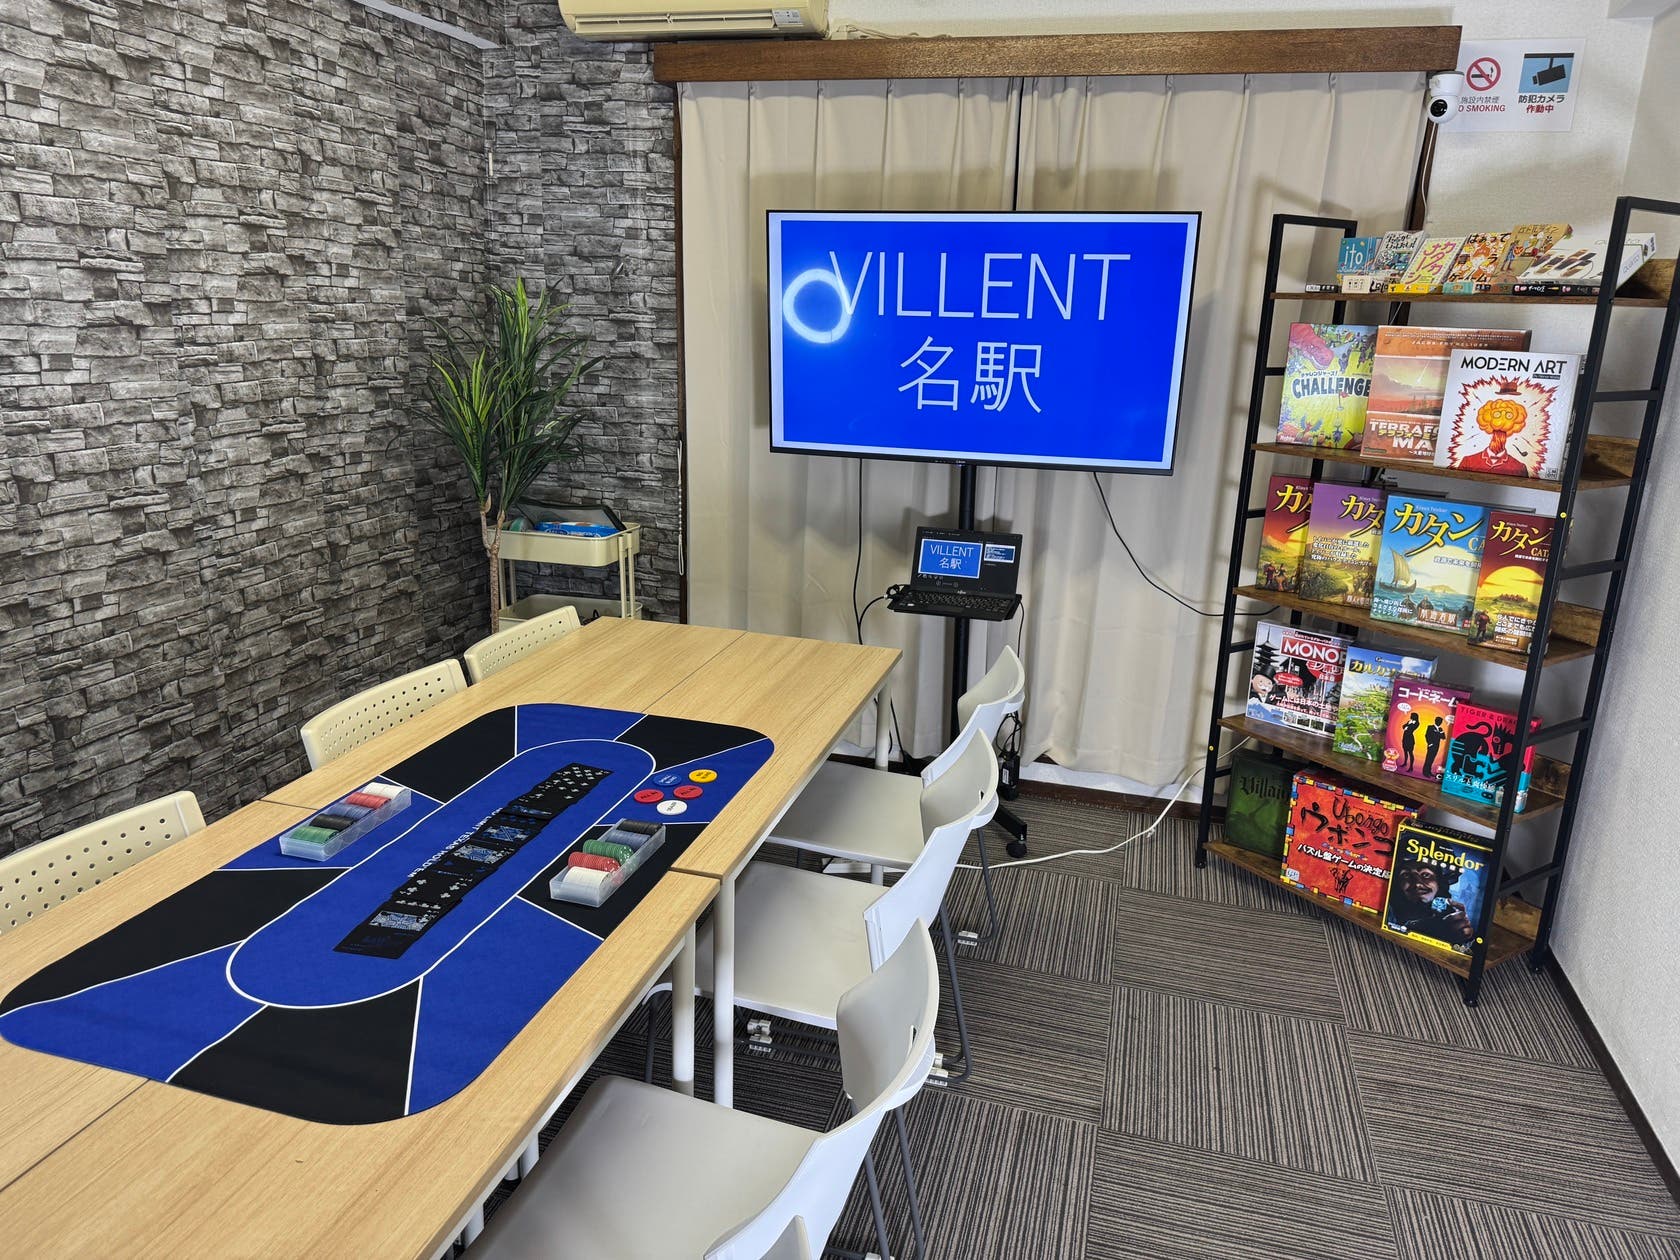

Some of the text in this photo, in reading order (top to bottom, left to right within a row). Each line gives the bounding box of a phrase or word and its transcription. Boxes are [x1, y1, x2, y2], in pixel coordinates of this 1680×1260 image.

[1466, 104, 1506, 112] SMOKING
[1518, 95, 1565, 104] 防犯カメラ
[1526, 104, 1554, 113] 作動中
[1344, 244, 1363, 268] ito
[829, 251, 1131, 320] VILLENT
[898, 336, 1042, 413] 名駅
[1460, 356, 1568, 374] MODERN ART
[1391, 503, 1484, 557] カタン
[1489, 521, 1552, 556] カタン
[930, 544, 974, 557] VILLENT
[939, 558, 962, 570] 名駅
[1460, 707, 1486, 719] TIGER
[1333, 797, 1388, 838] Ubongo
[1406, 838, 1485, 870] Splendor
